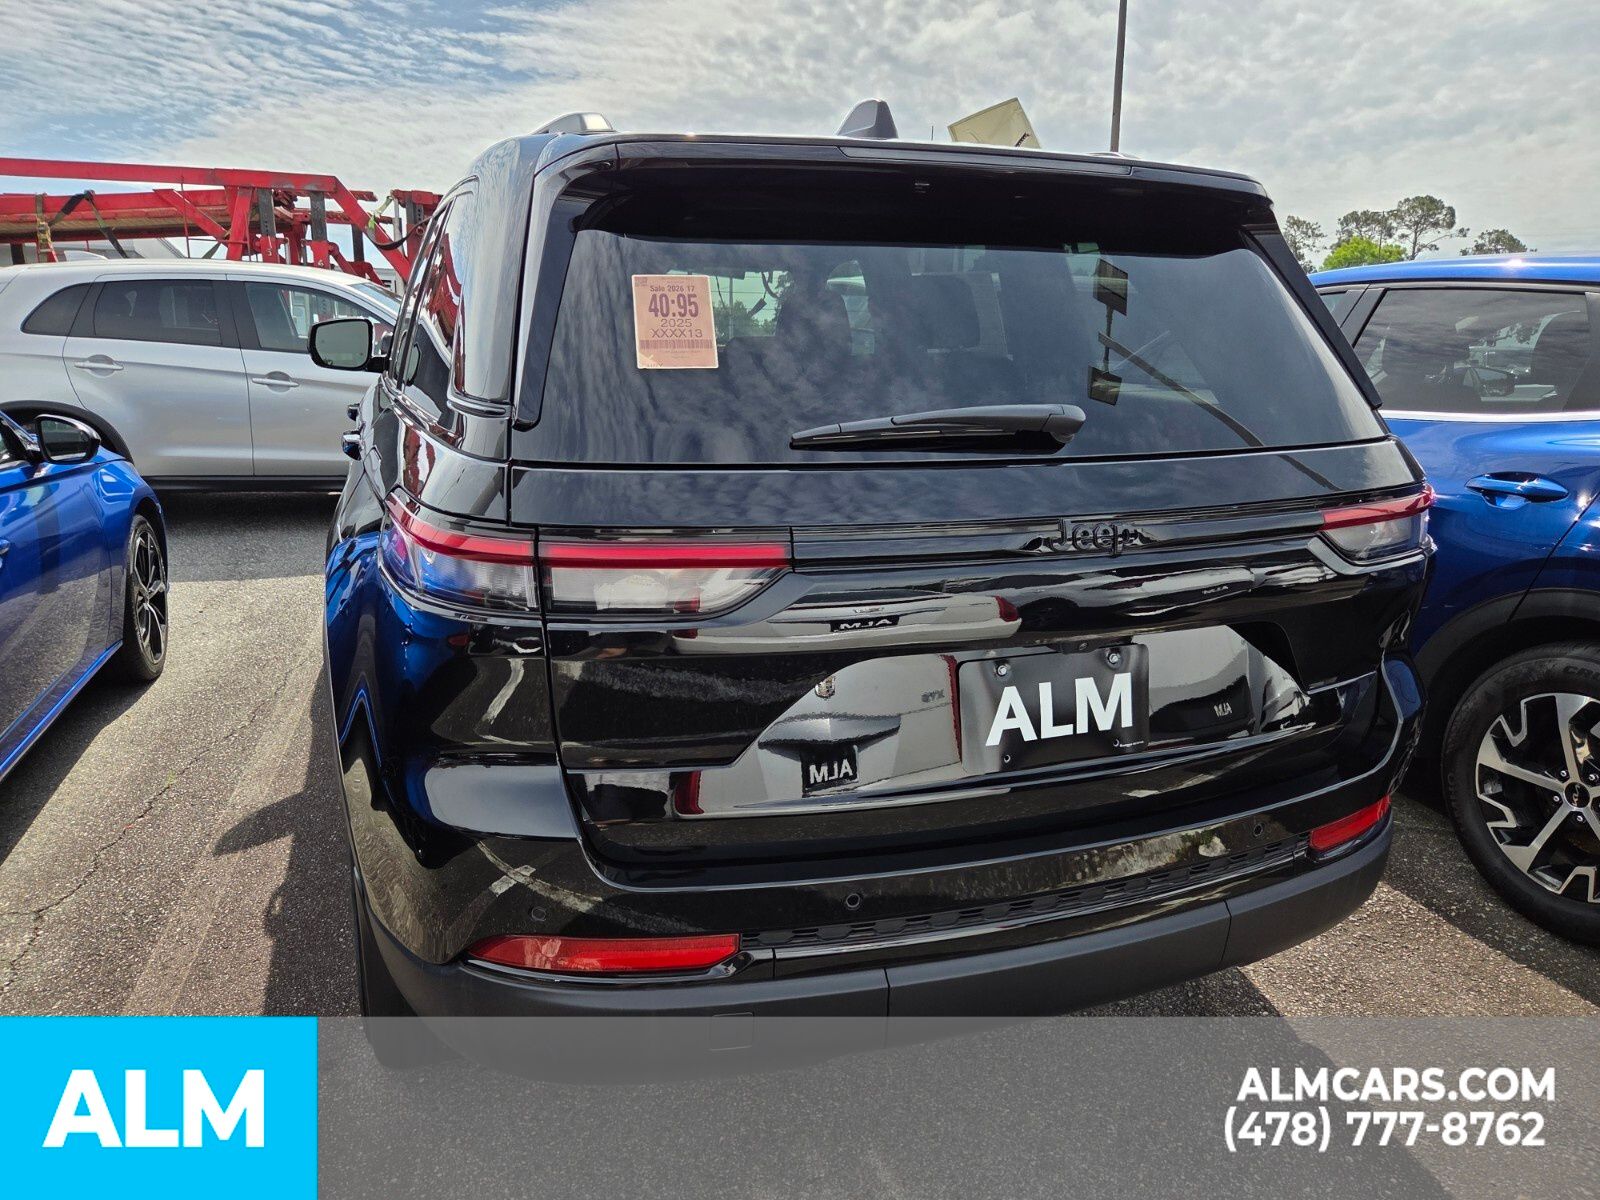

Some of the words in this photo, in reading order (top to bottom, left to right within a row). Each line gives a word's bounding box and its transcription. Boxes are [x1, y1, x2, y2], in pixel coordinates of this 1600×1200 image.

[651, 328, 703, 338] XXXX13
[660, 318, 693, 328] 2025
[1051, 518, 1134, 557] Jeep
[985, 672, 1133, 747] ALM
